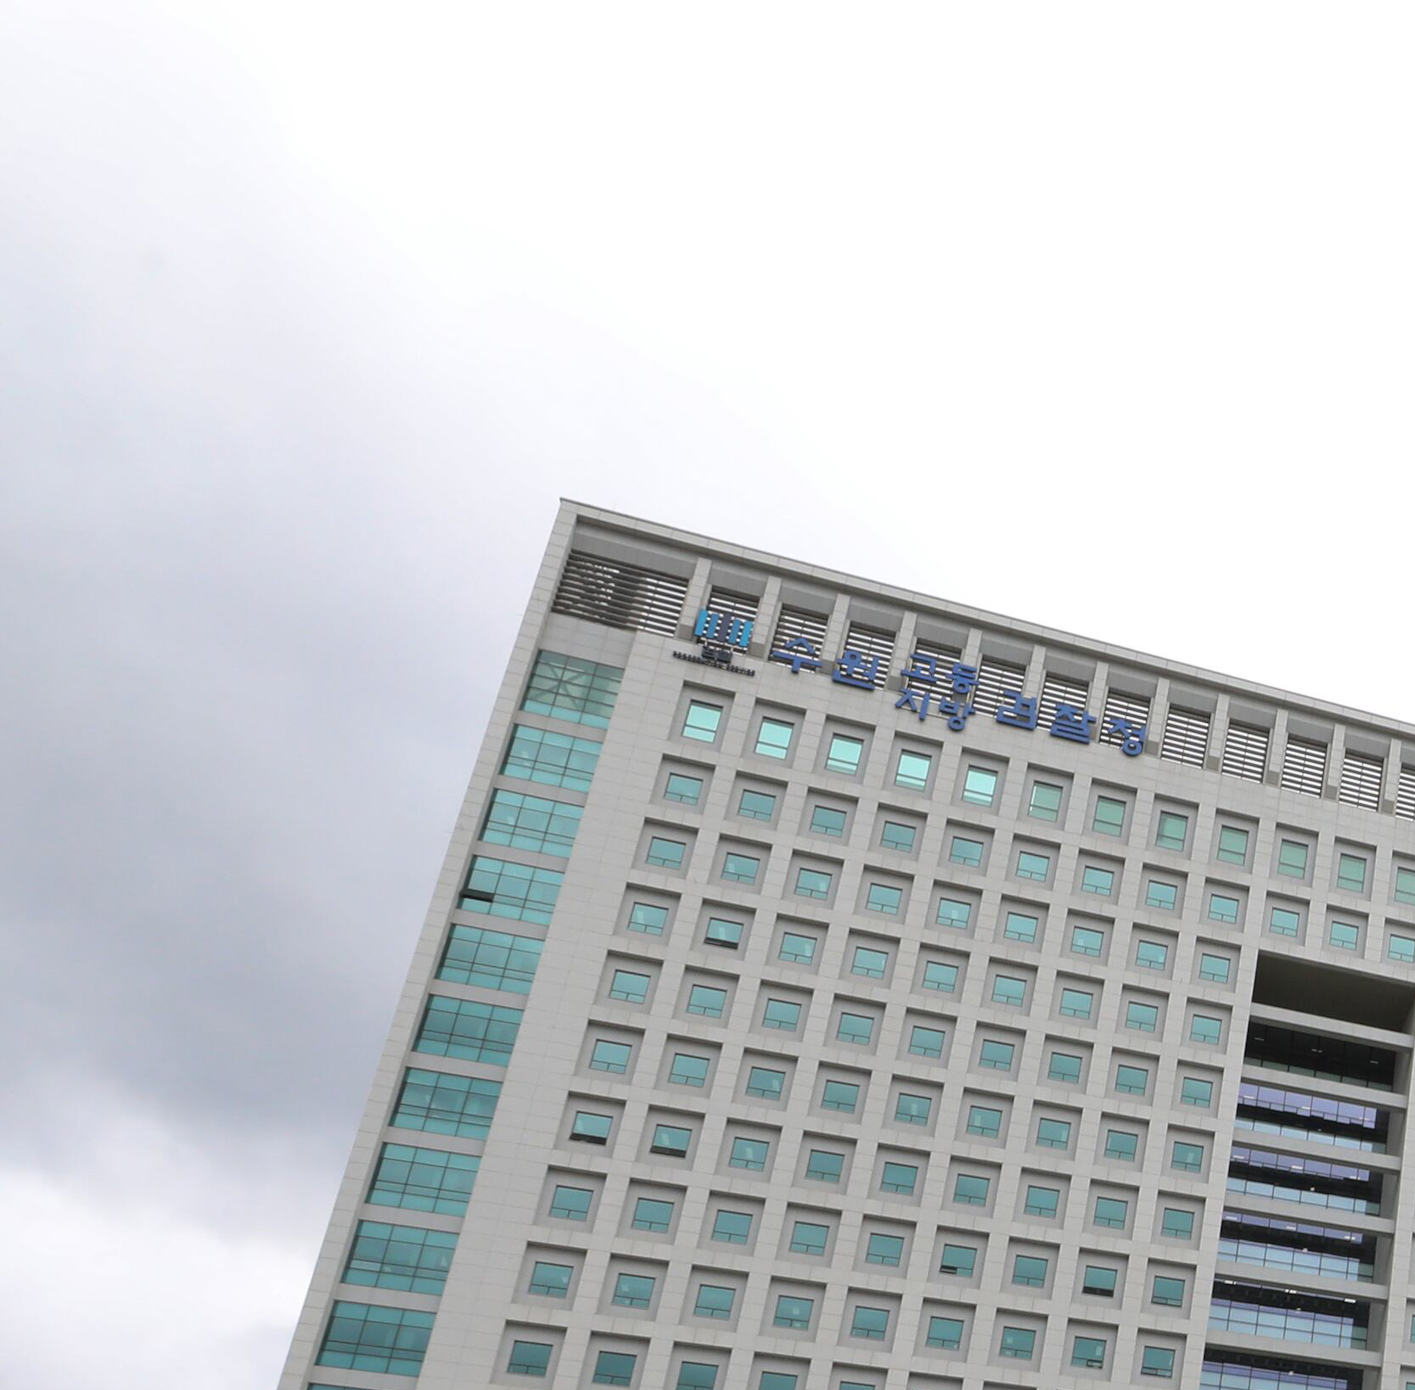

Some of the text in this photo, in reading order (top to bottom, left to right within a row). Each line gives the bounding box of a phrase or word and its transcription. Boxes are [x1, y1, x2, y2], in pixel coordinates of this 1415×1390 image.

[771, 636, 880, 691] 수원
[901, 652, 979, 694] 고등
[894, 687, 1146, 757] 지방 검찰청
